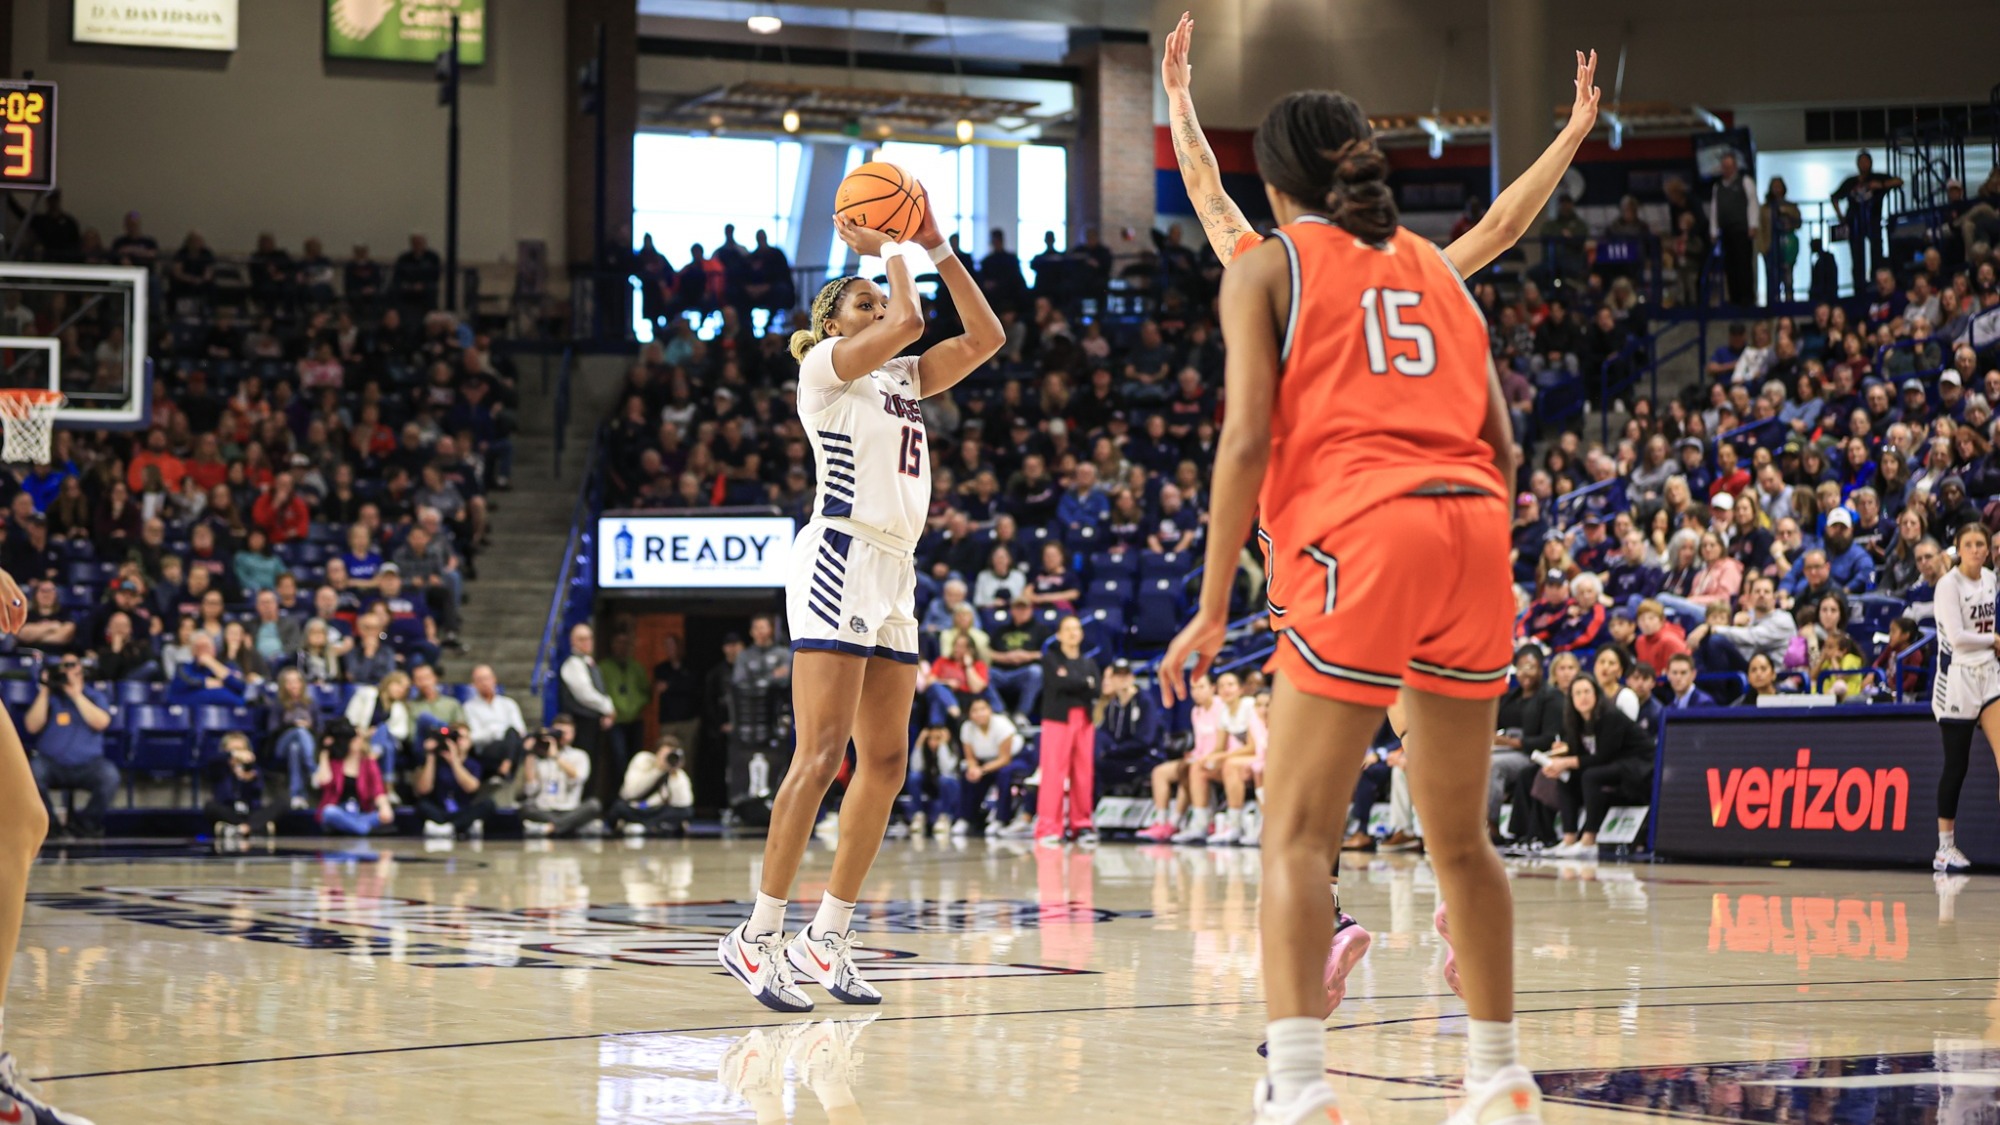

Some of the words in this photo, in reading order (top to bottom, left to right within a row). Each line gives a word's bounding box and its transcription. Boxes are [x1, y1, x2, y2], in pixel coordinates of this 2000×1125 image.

[4, 123, 32, 176] 3
[1360, 286, 1437, 377] 15
[898, 425, 923, 478] 15
[645, 536, 771, 562] READY
[1706, 748, 1910, 832] verizon
